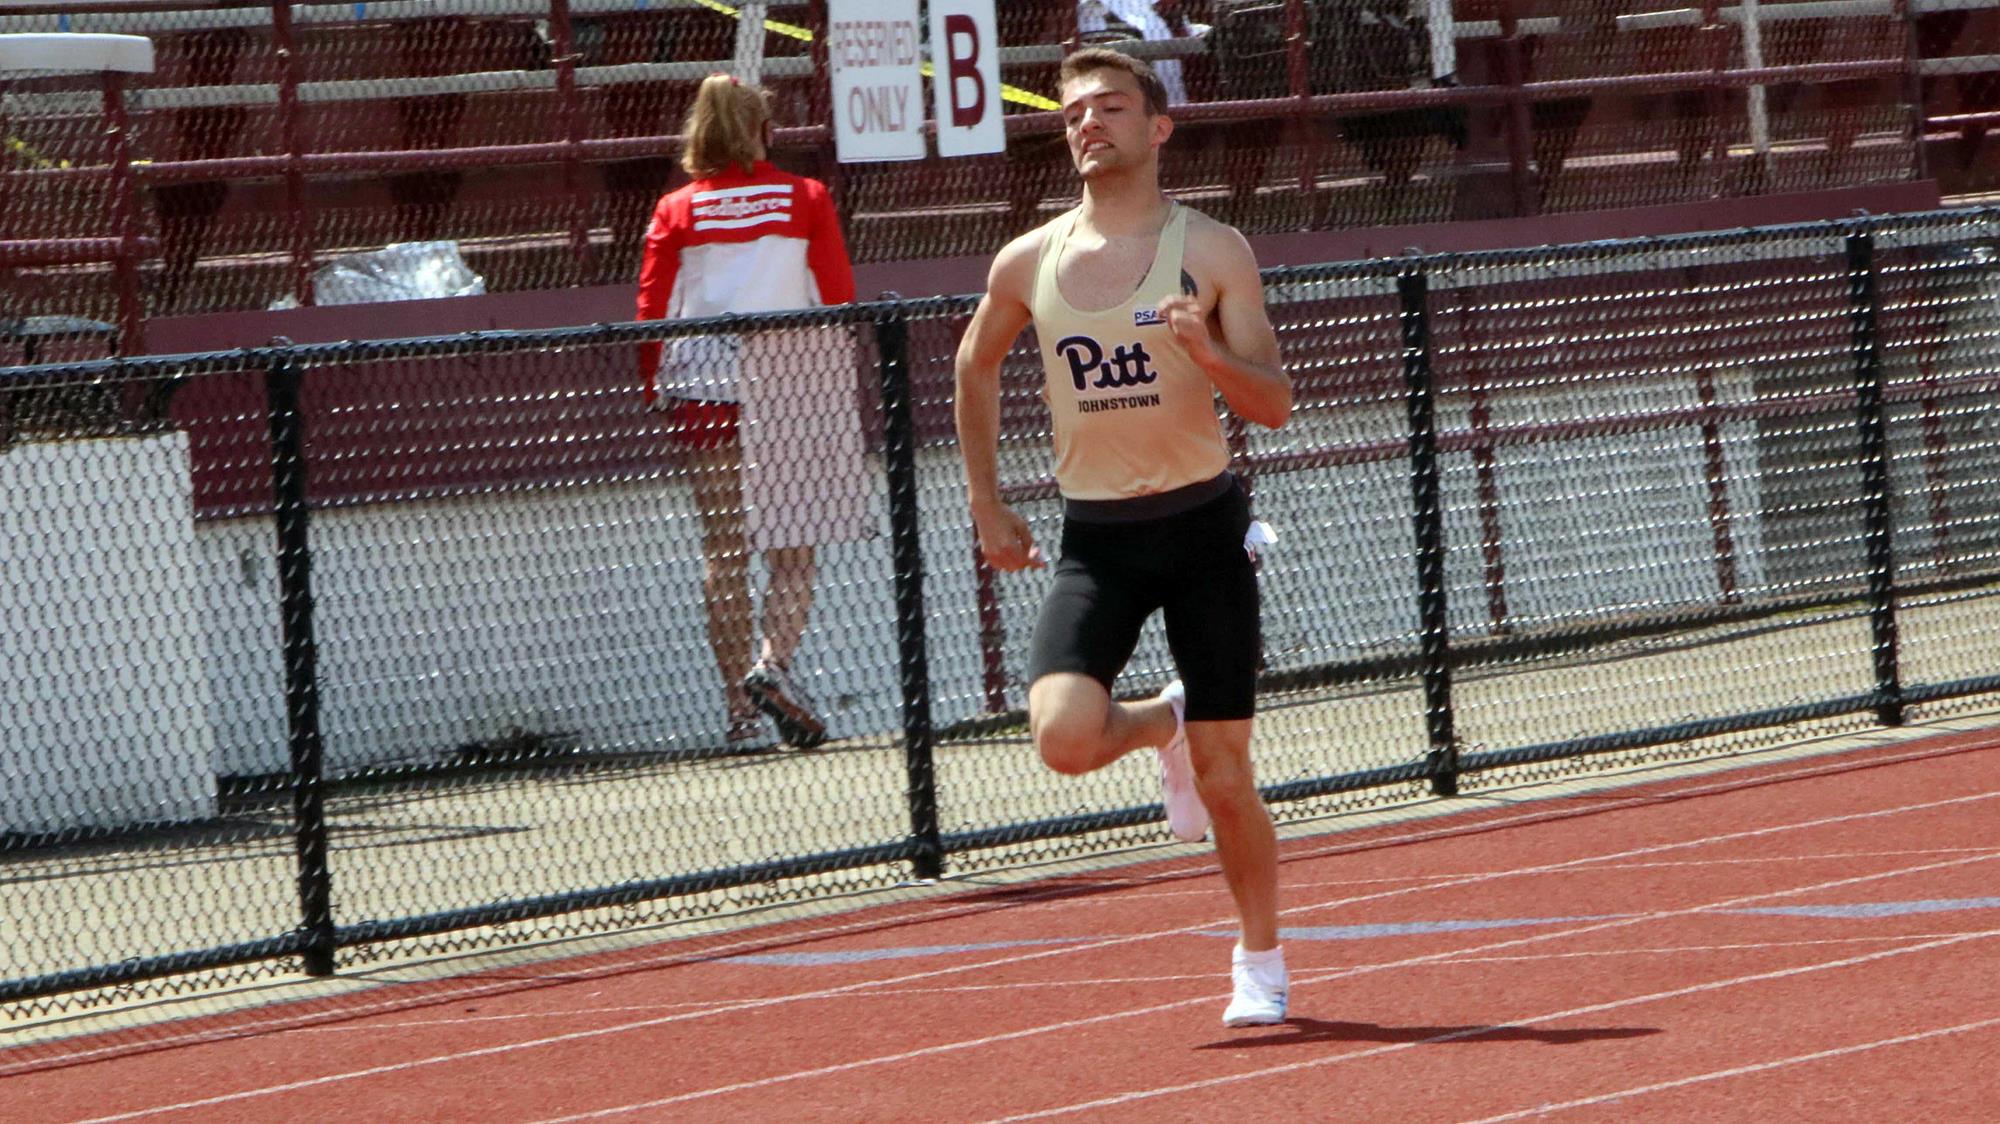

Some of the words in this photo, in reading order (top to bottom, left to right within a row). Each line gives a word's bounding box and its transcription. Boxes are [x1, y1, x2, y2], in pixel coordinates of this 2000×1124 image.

[944, 14, 986, 127] B
[847, 84, 909, 134] ONLY
[1134, 309, 1167, 321] PSA
[1055, 335, 1157, 391] Pitt
[1078, 394, 1161, 414] JOHNSTOWN
